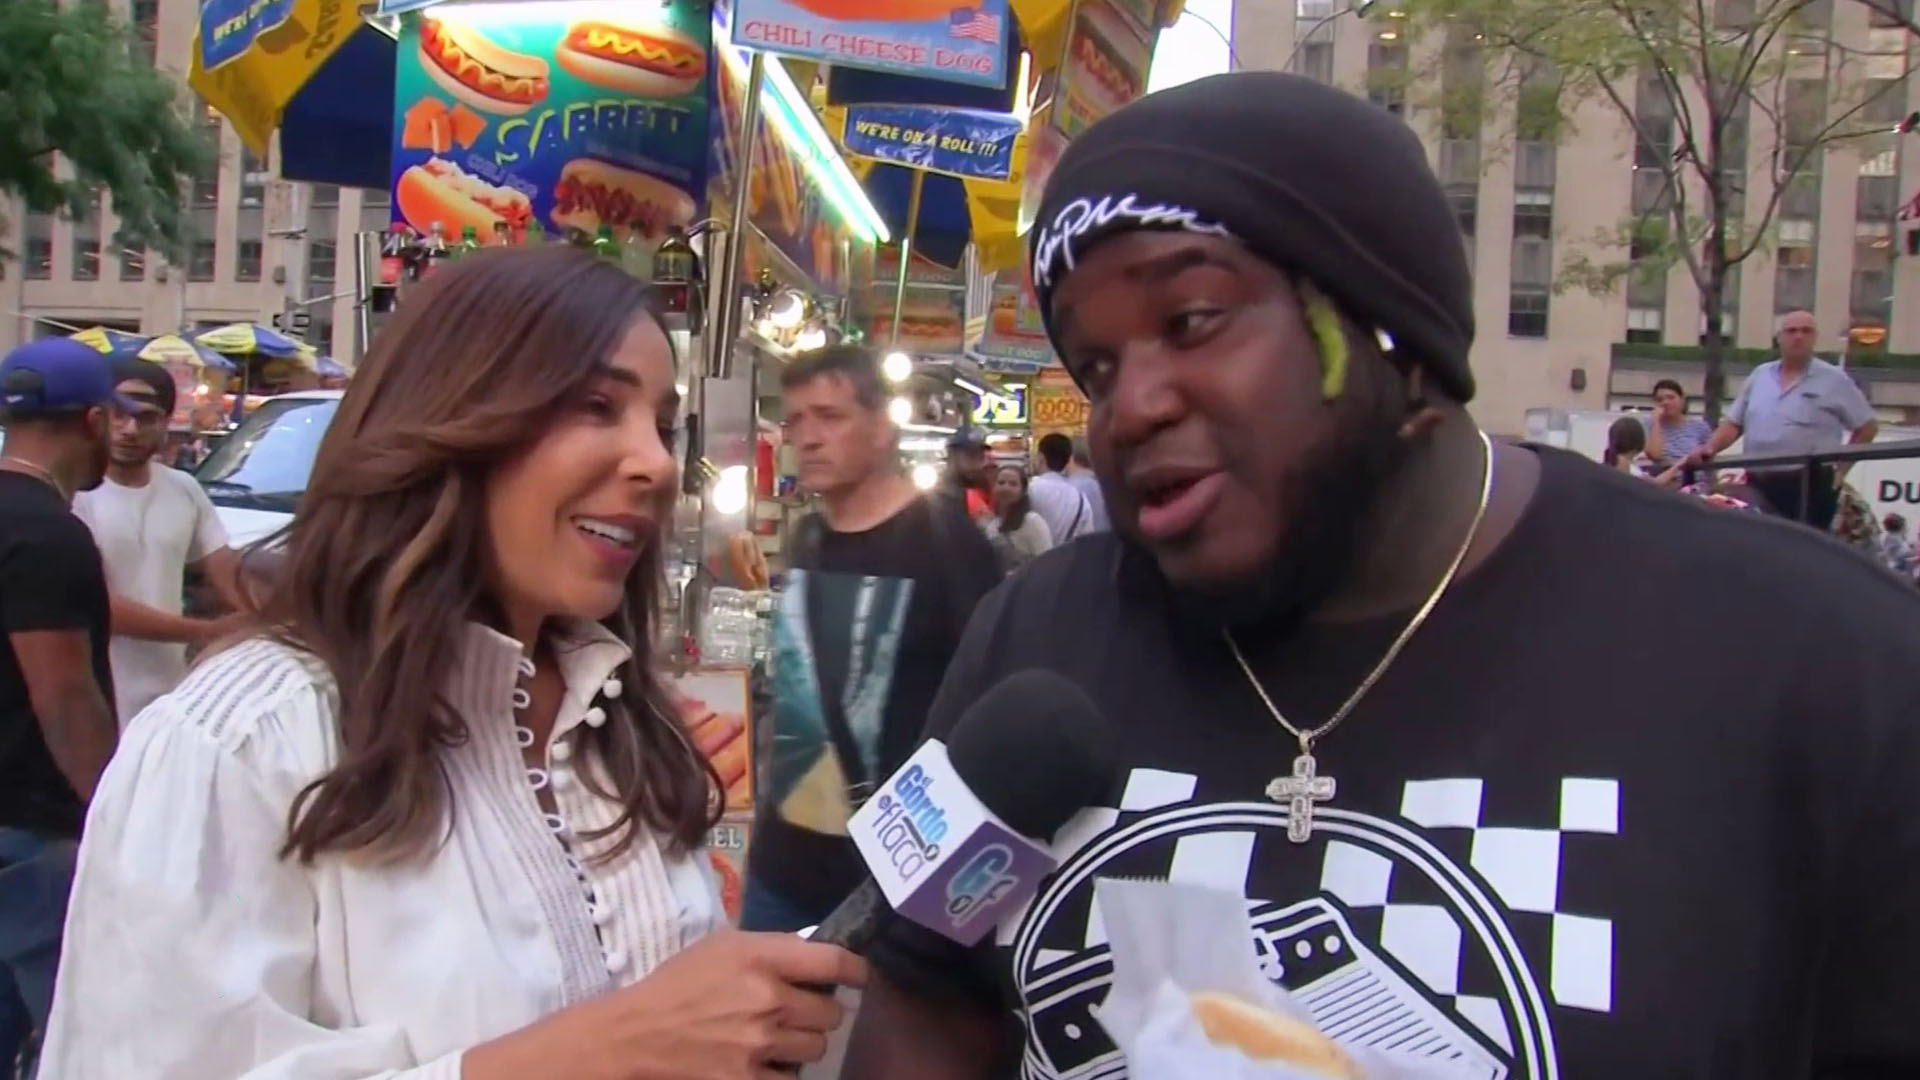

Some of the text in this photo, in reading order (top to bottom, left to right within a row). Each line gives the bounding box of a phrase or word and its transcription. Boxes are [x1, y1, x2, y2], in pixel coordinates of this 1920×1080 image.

[744, 20, 993, 74] CHILI CHEESE DOG
[855, 120, 898, 140] WE'RE
[939, 136, 974, 154] ROLL
[894, 763, 948, 842] Gordo
[872, 800, 926, 883] flaca
